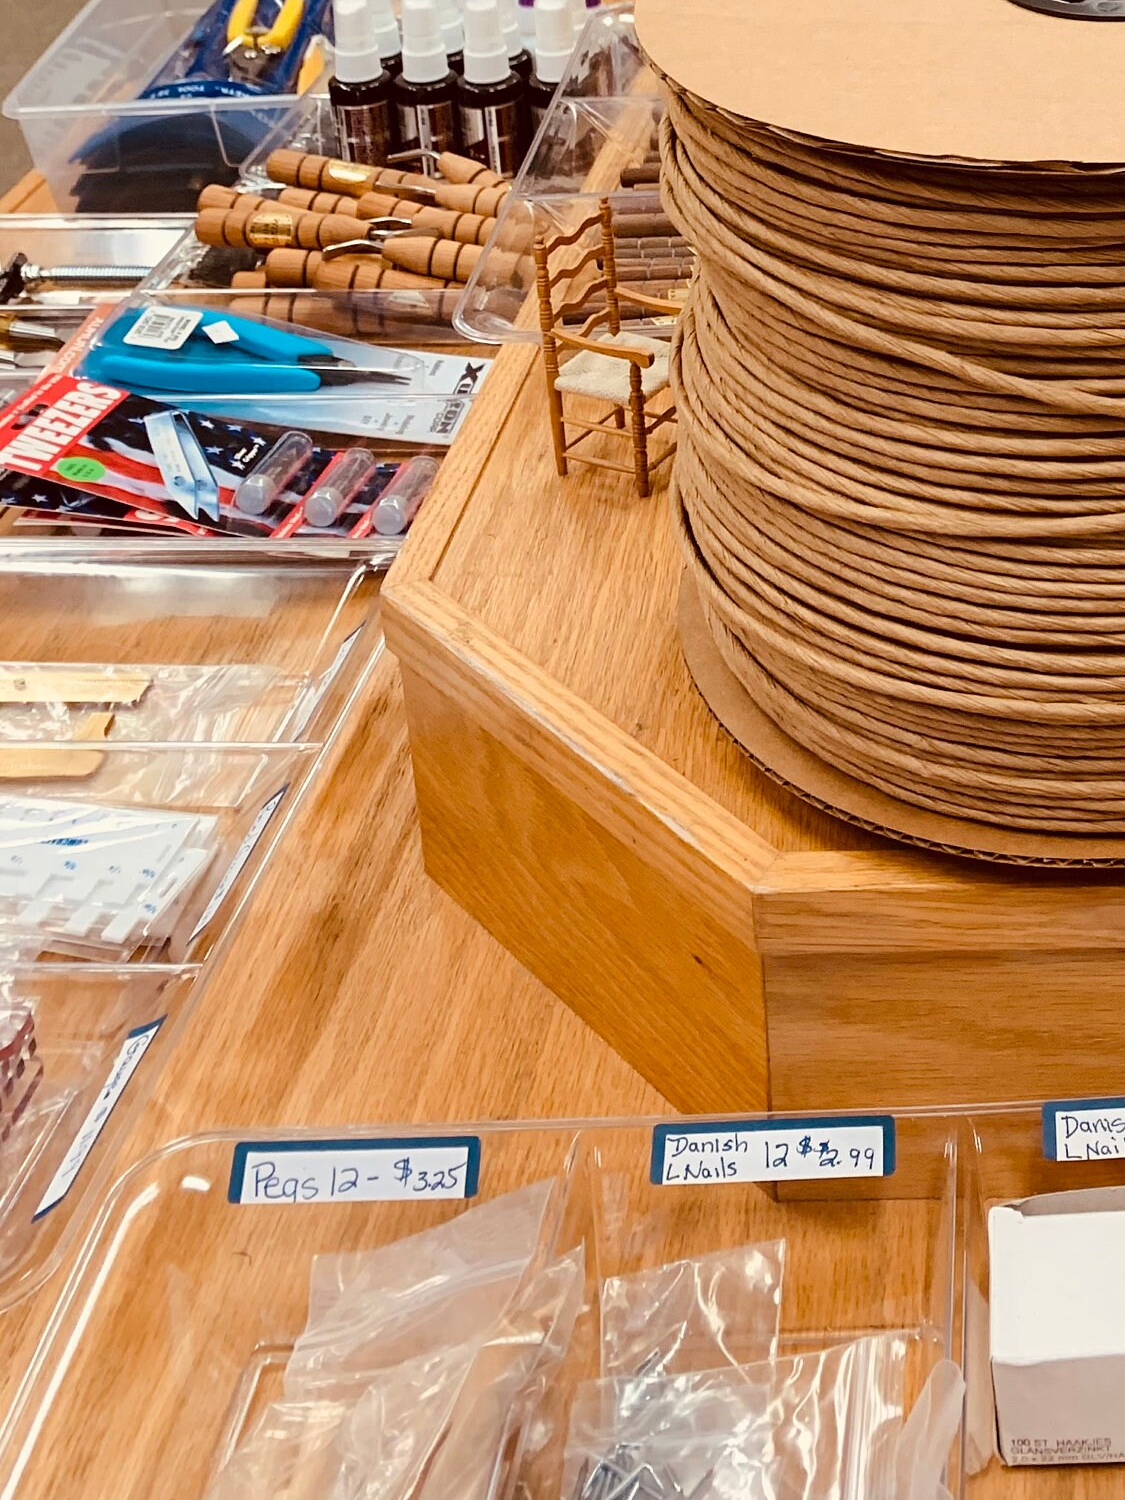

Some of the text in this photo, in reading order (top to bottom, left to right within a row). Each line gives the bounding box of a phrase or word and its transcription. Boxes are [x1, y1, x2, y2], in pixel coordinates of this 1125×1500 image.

[0, 382, 121, 472] TWEEZERS
[667, 1133, 748, 1157] Danish
[765, 1141, 789, 1169] 12
[251, 1161, 319, 1203] Pegs
[330, 1166, 360, 1196] 12
